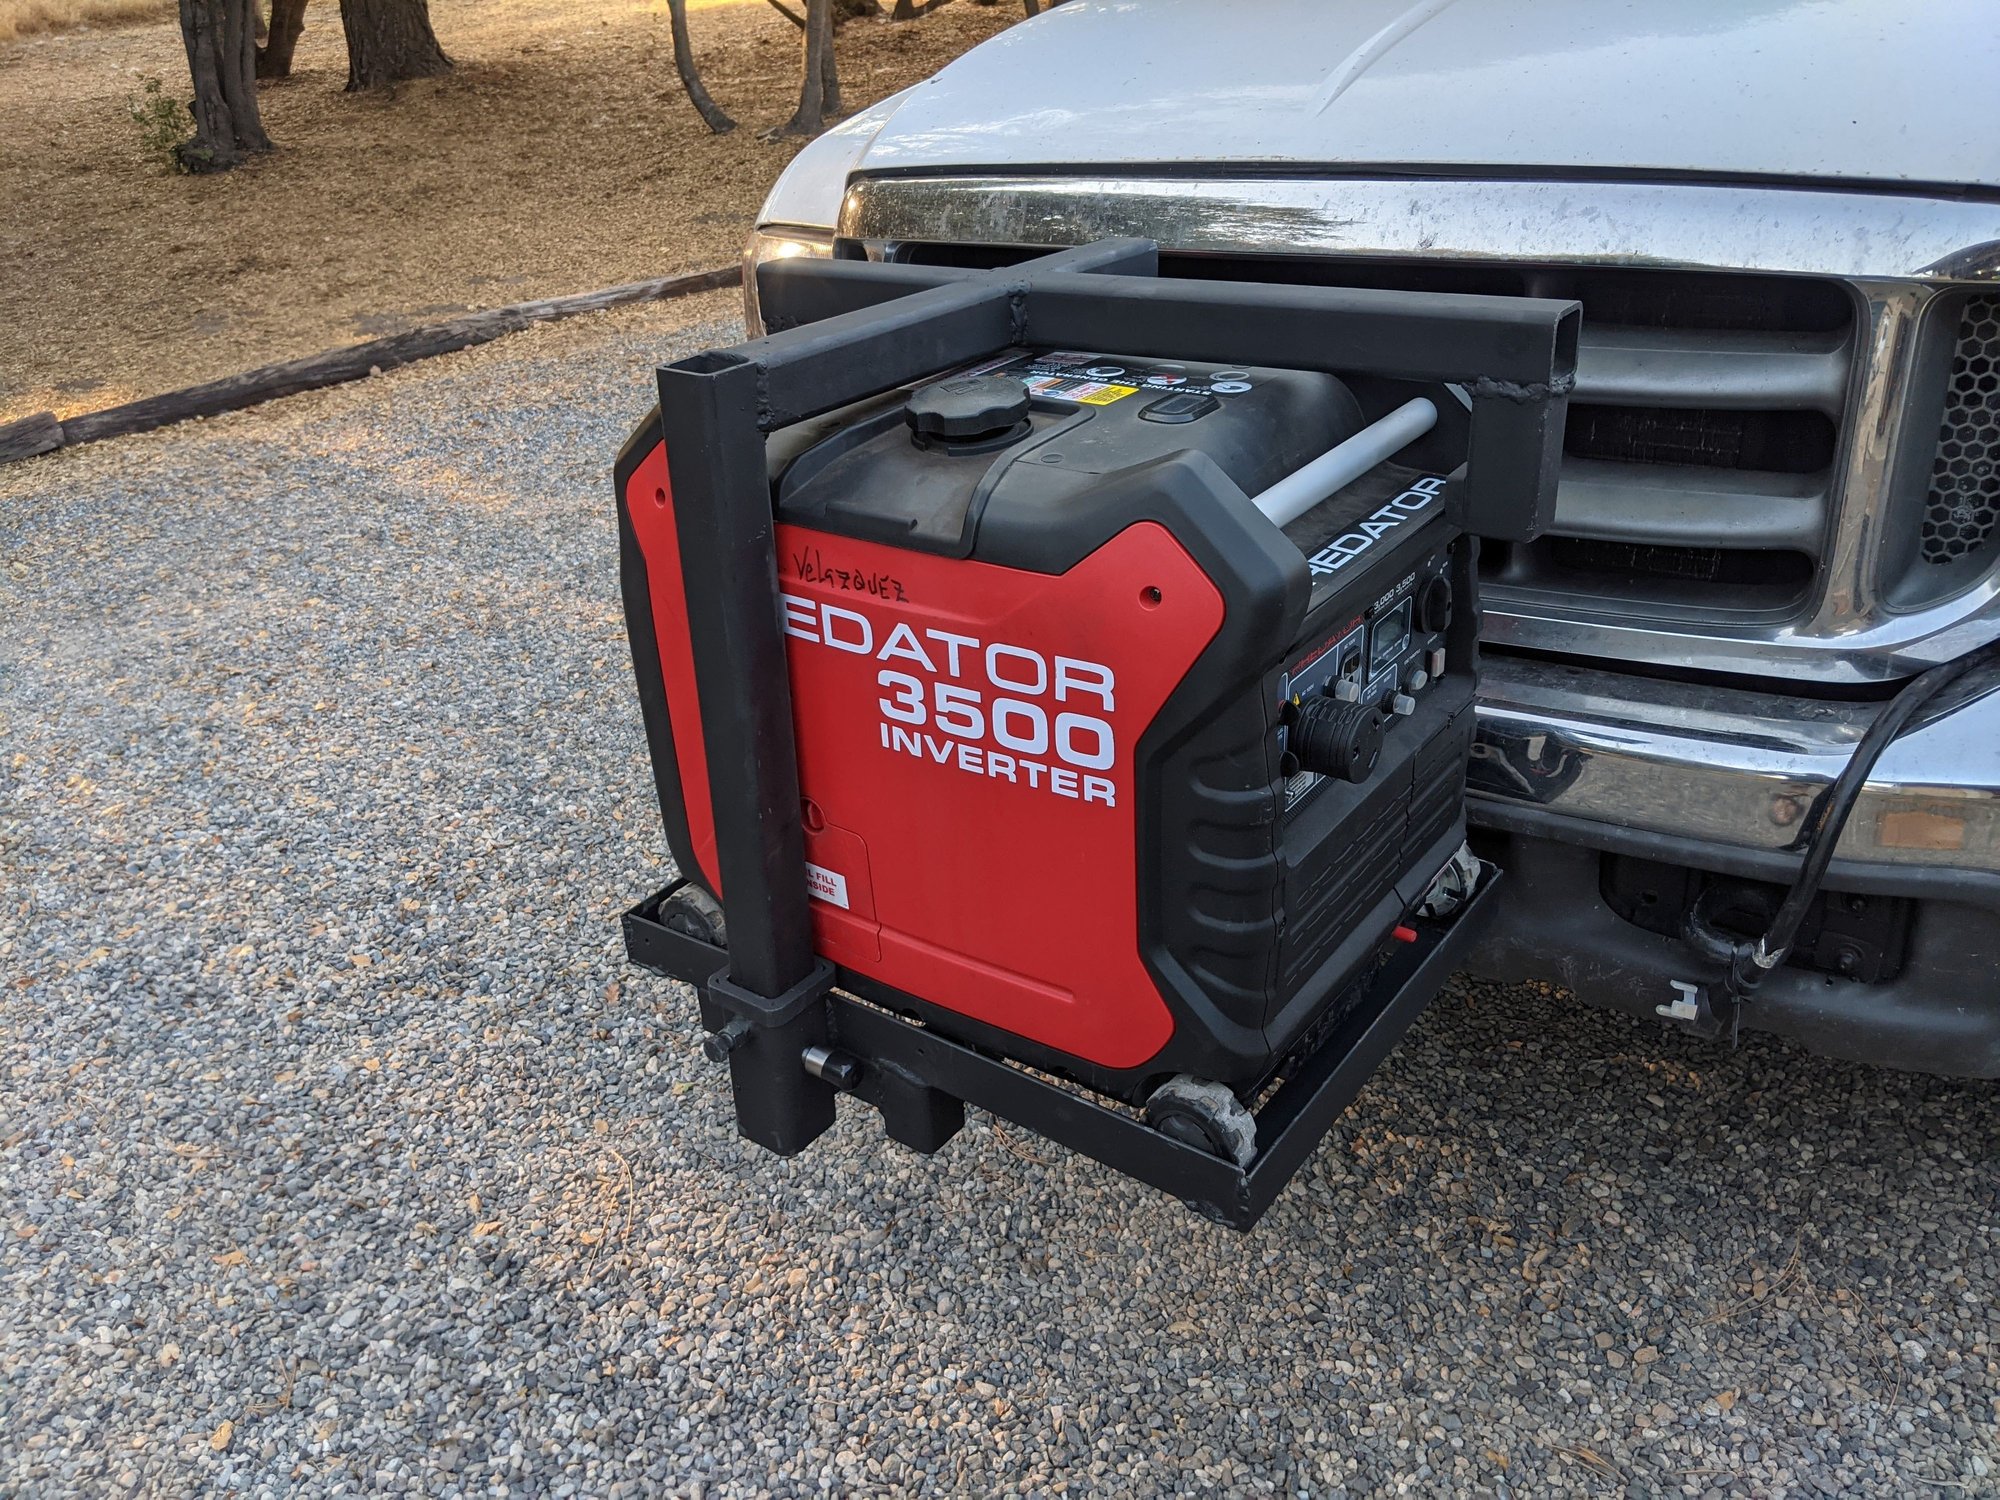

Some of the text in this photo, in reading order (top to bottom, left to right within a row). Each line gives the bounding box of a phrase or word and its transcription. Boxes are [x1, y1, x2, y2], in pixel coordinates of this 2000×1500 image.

[1029, 370, 1109, 383] GENERATOR
[1110, 379, 1138, 387] THE
[1140, 383, 1212, 396] STARTING
[1373, 588, 1395, 610] 3,000
[1395, 571, 1416, 593] 3,500
[781, 592, 1115, 712] EDATOR
[877, 670, 1115, 771] 3500
[880, 722, 1116, 807] INVERTER
[807, 879, 836, 897] NSIDE
[816, 872, 837, 887] FILL
